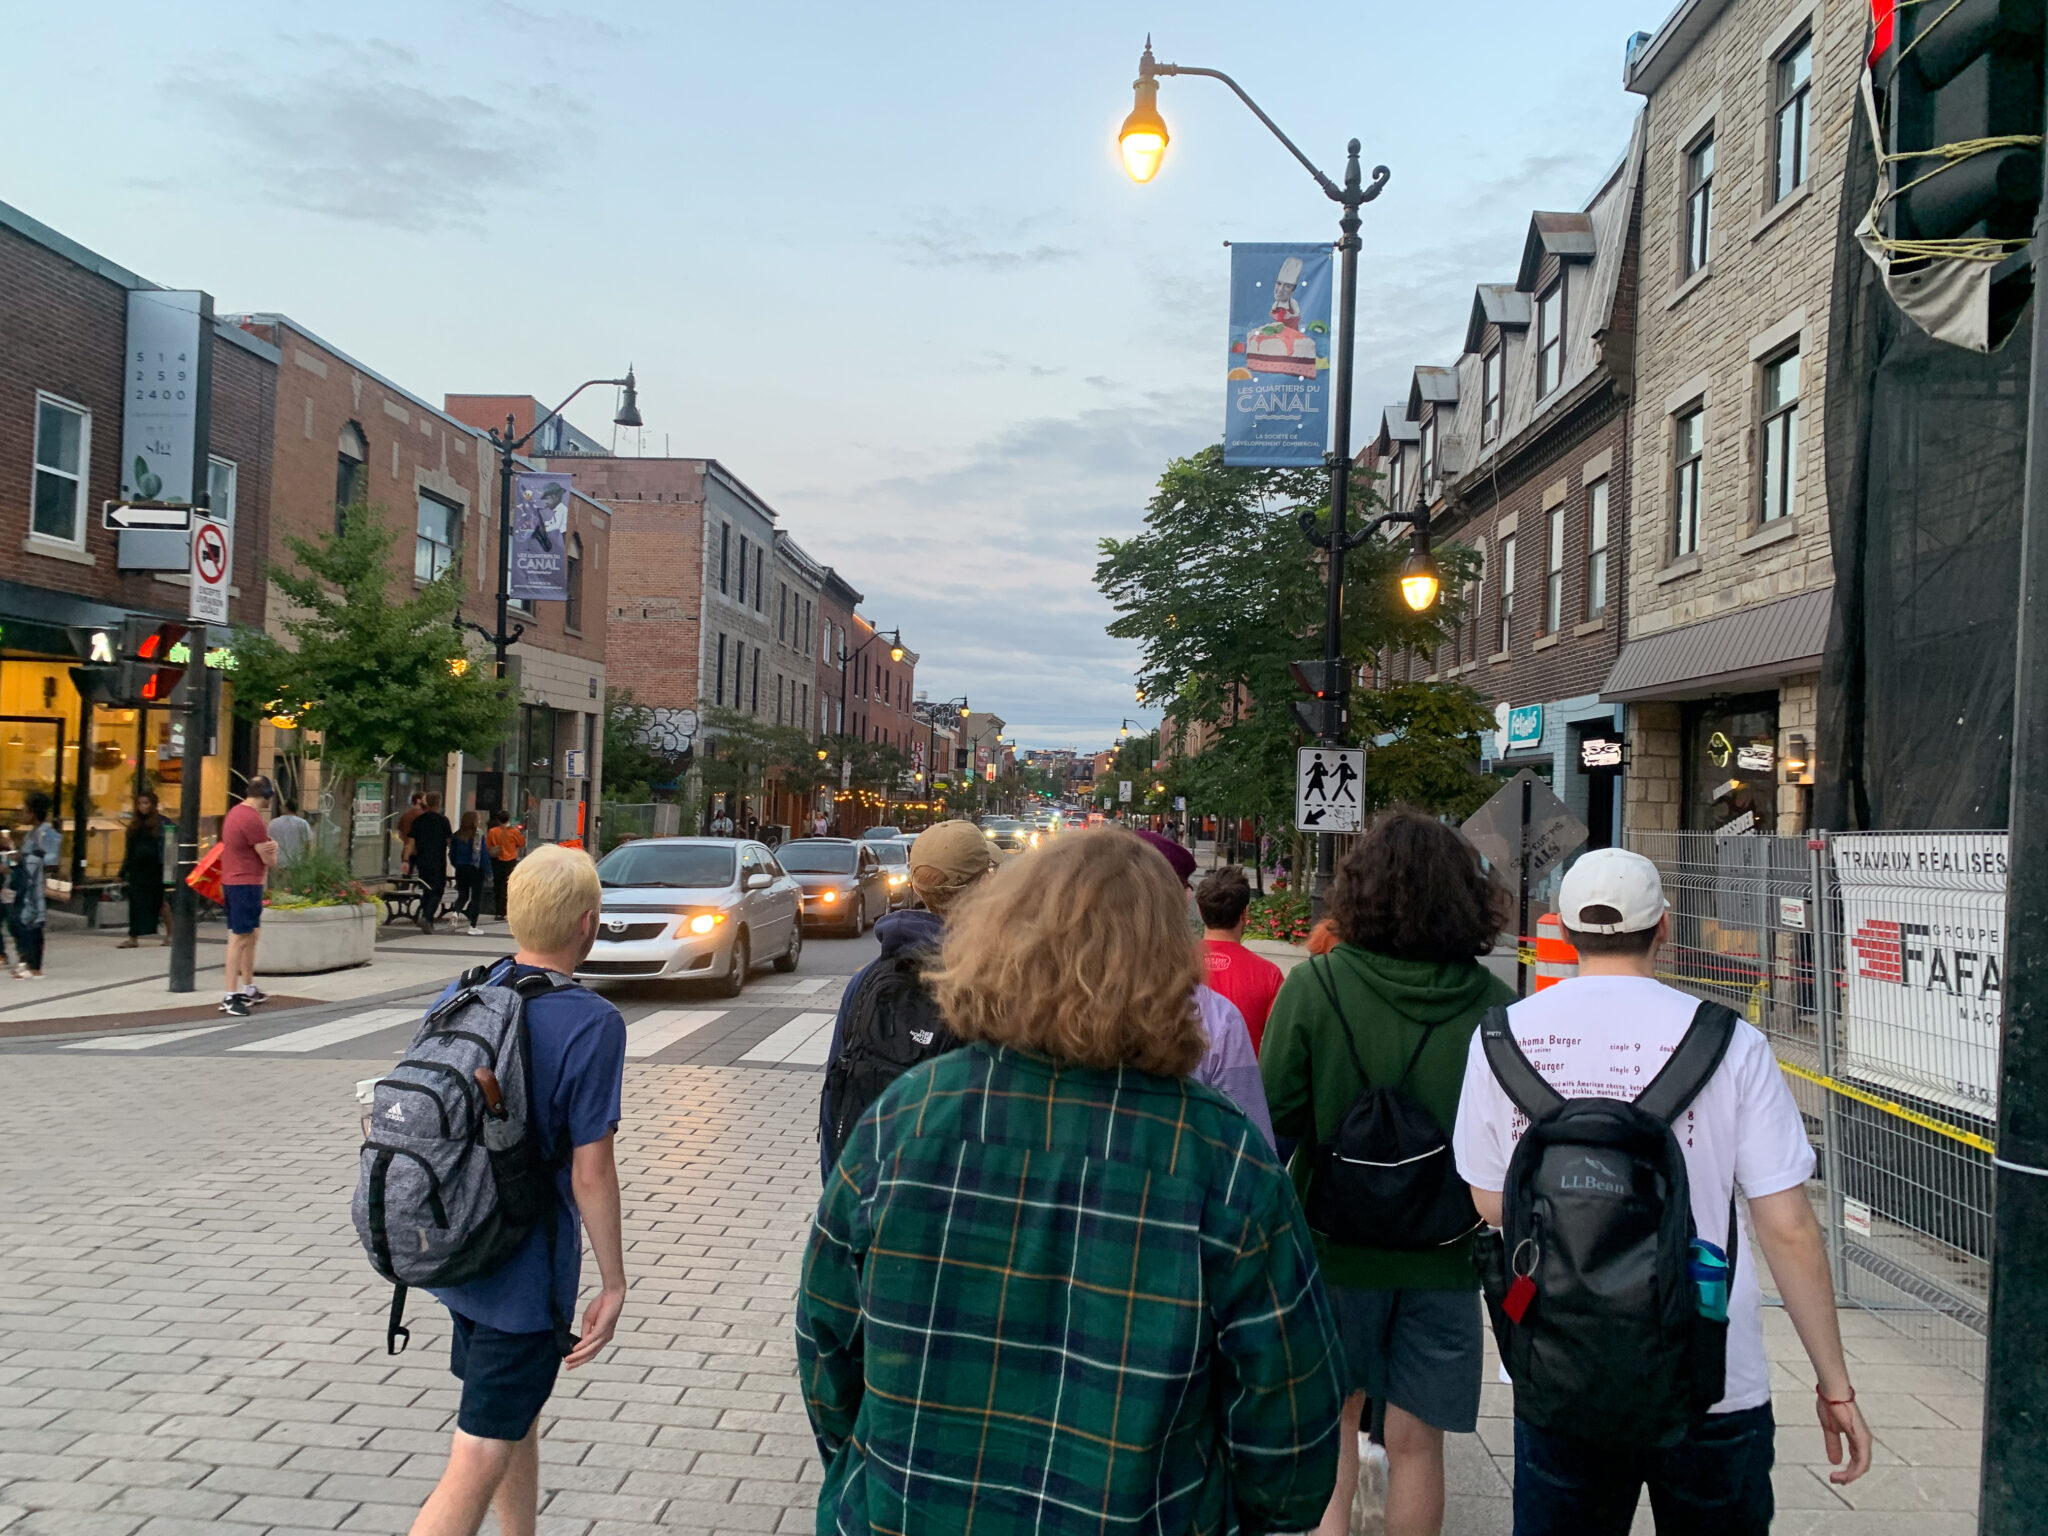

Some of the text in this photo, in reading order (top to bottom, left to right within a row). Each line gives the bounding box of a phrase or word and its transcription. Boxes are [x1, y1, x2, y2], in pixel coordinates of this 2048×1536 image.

[135, 390, 186, 400] 2400
[1237, 385, 1320, 395] LES QUARTIERS DU
[1236, 393, 1320, 413] CANAL
[516, 557, 561, 571] CANAL
[1841, 846, 2007, 874] TRAVAUX RÉALISÉS
[1932, 924, 1999, 943] GROUPE
[909, 1030, 929, 1041] NORTH
[1516, 1034, 1582, 1048] ahoma Burger
[1609, 1043, 1630, 1052] single
[1634, 1043, 1641, 1052] 9
[1534, 1060, 1565, 1074] Burger
[1609, 1065, 1641, 1076] single 9
[1577, 1080, 1605, 1088] American
[385, 1112, 405, 1123] adidas
[1687, 1110, 1695, 1121] 8
[1687, 1124, 1695, 1135] 7
[1686, 1137, 1694, 1149] 4
[1560, 1174, 1625, 1194] L.L.Bean
